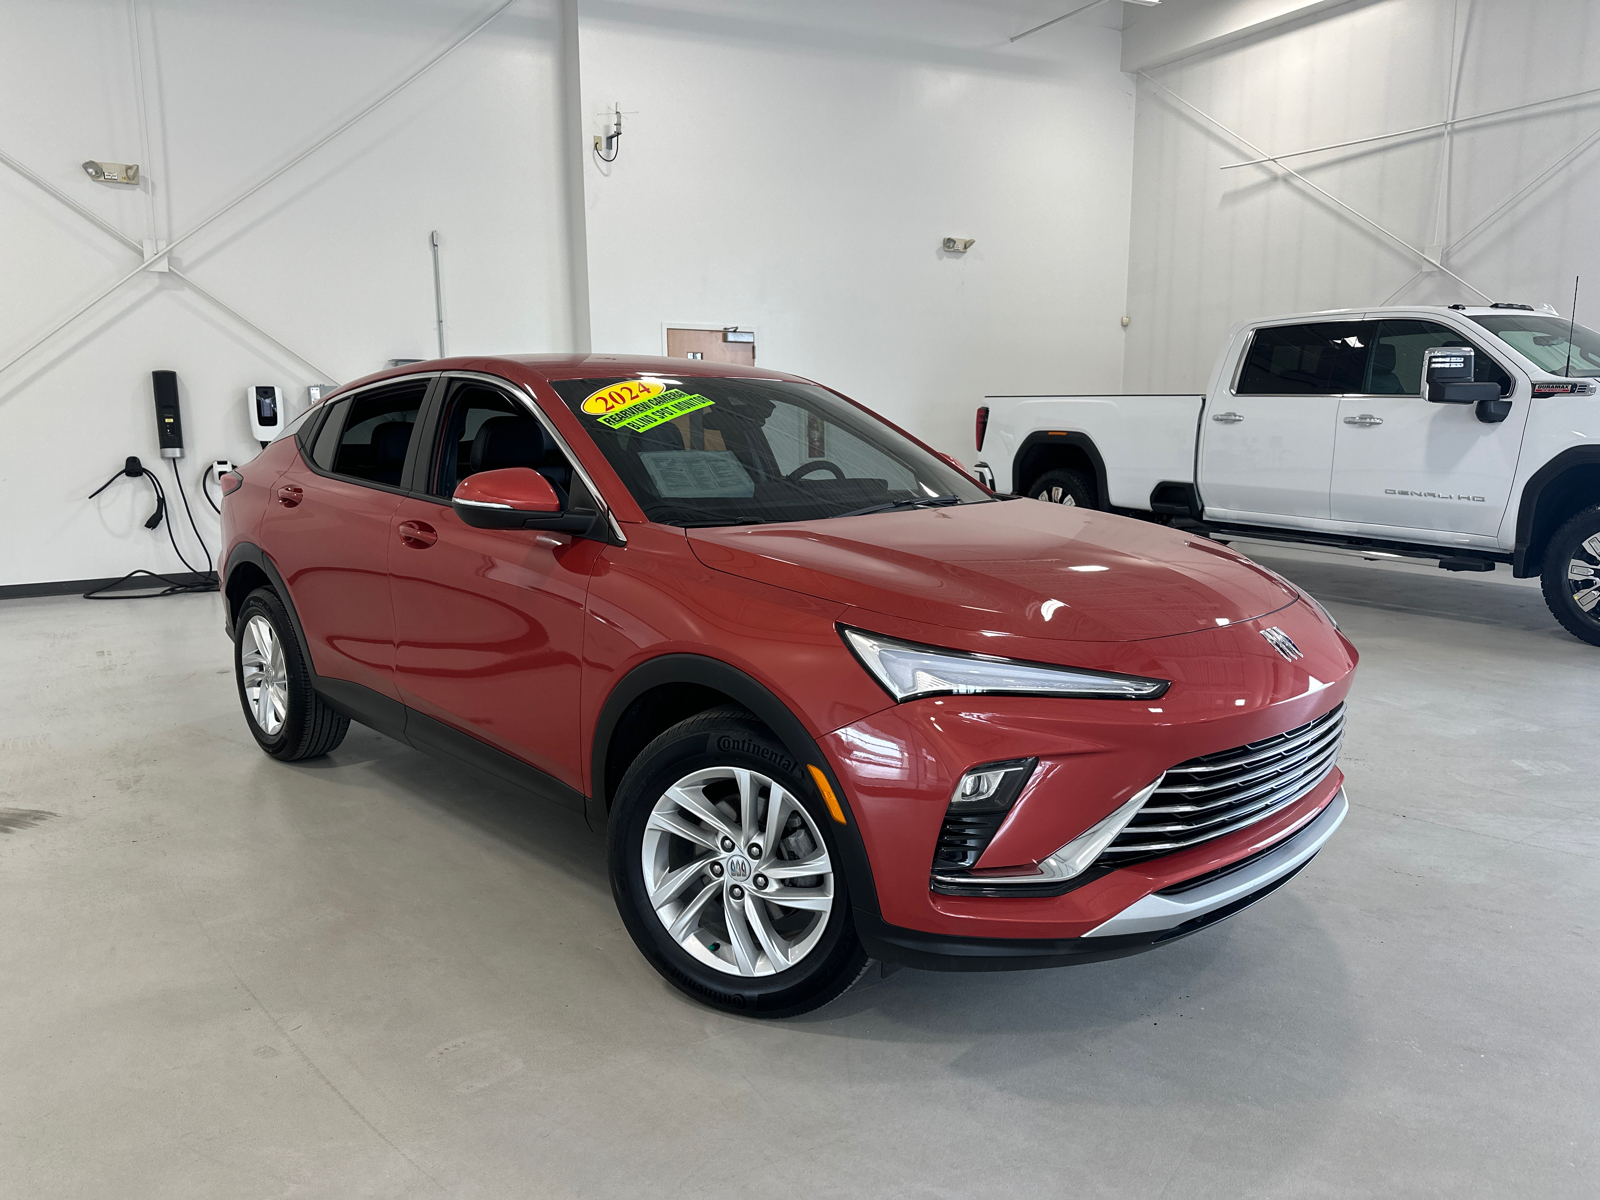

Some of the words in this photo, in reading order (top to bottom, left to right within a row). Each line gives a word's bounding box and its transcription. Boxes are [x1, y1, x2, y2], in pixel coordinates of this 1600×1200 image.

[595, 381, 651, 412] 2024
[603, 398, 654, 426] REARVIEW
[647, 390, 687, 407] CAMERA
[625, 414, 658, 431] BLIND
[651, 406, 678, 420] SPOT
[670, 395, 711, 412] MONITOR
[1384, 488, 1454, 499] DENALI
[1457, 494, 1486, 502] HD
[716, 735, 801, 774] Continental
